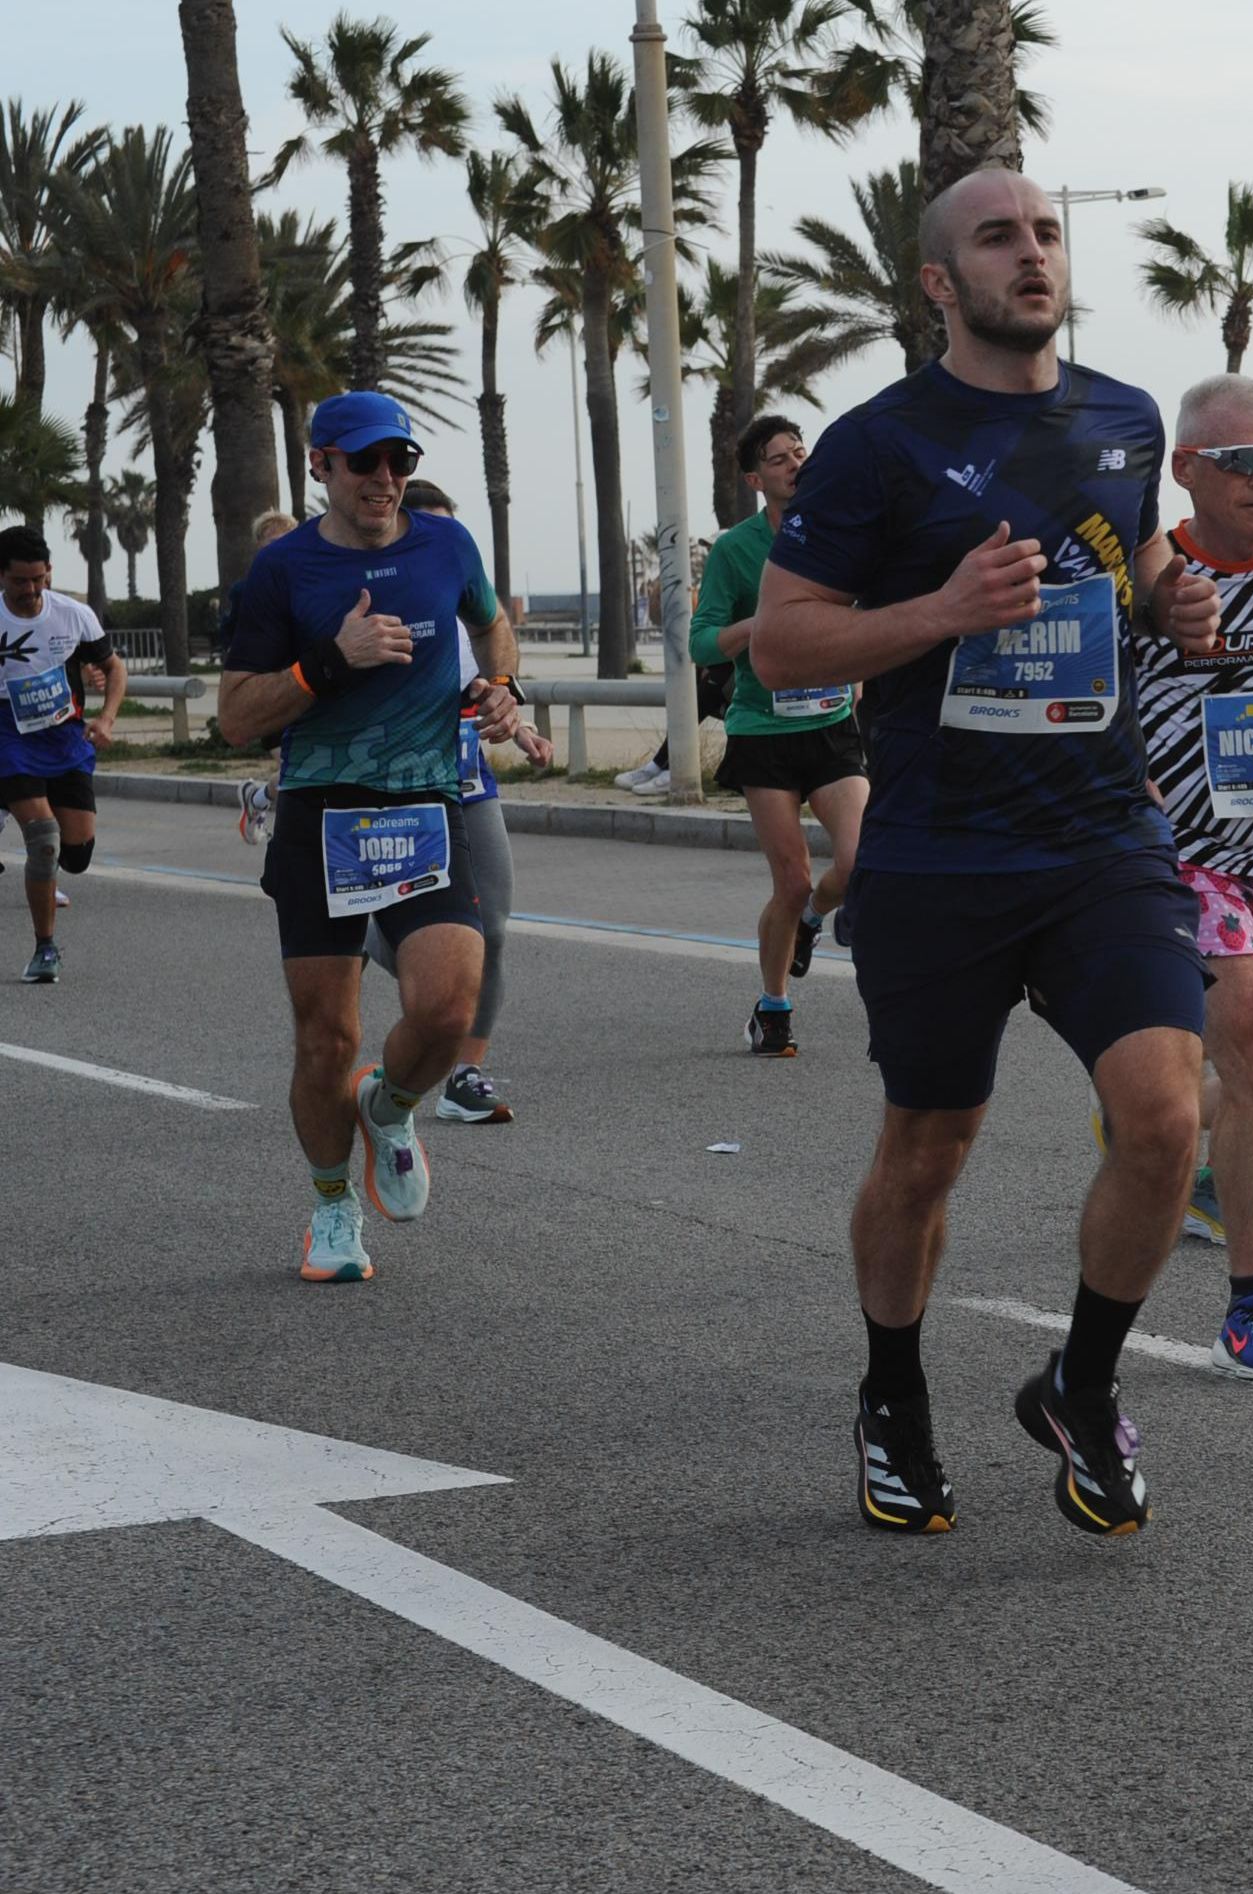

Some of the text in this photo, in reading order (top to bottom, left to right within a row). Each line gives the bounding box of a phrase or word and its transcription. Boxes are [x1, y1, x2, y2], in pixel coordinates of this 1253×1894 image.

[1014, 661, 1054, 681] 7952
[18, 682, 63, 706] NICOLAS
[968, 705, 1021, 718] BROOKS
[372, 817, 419, 829] eDreams
[358, 836, 415, 862] JORDI
